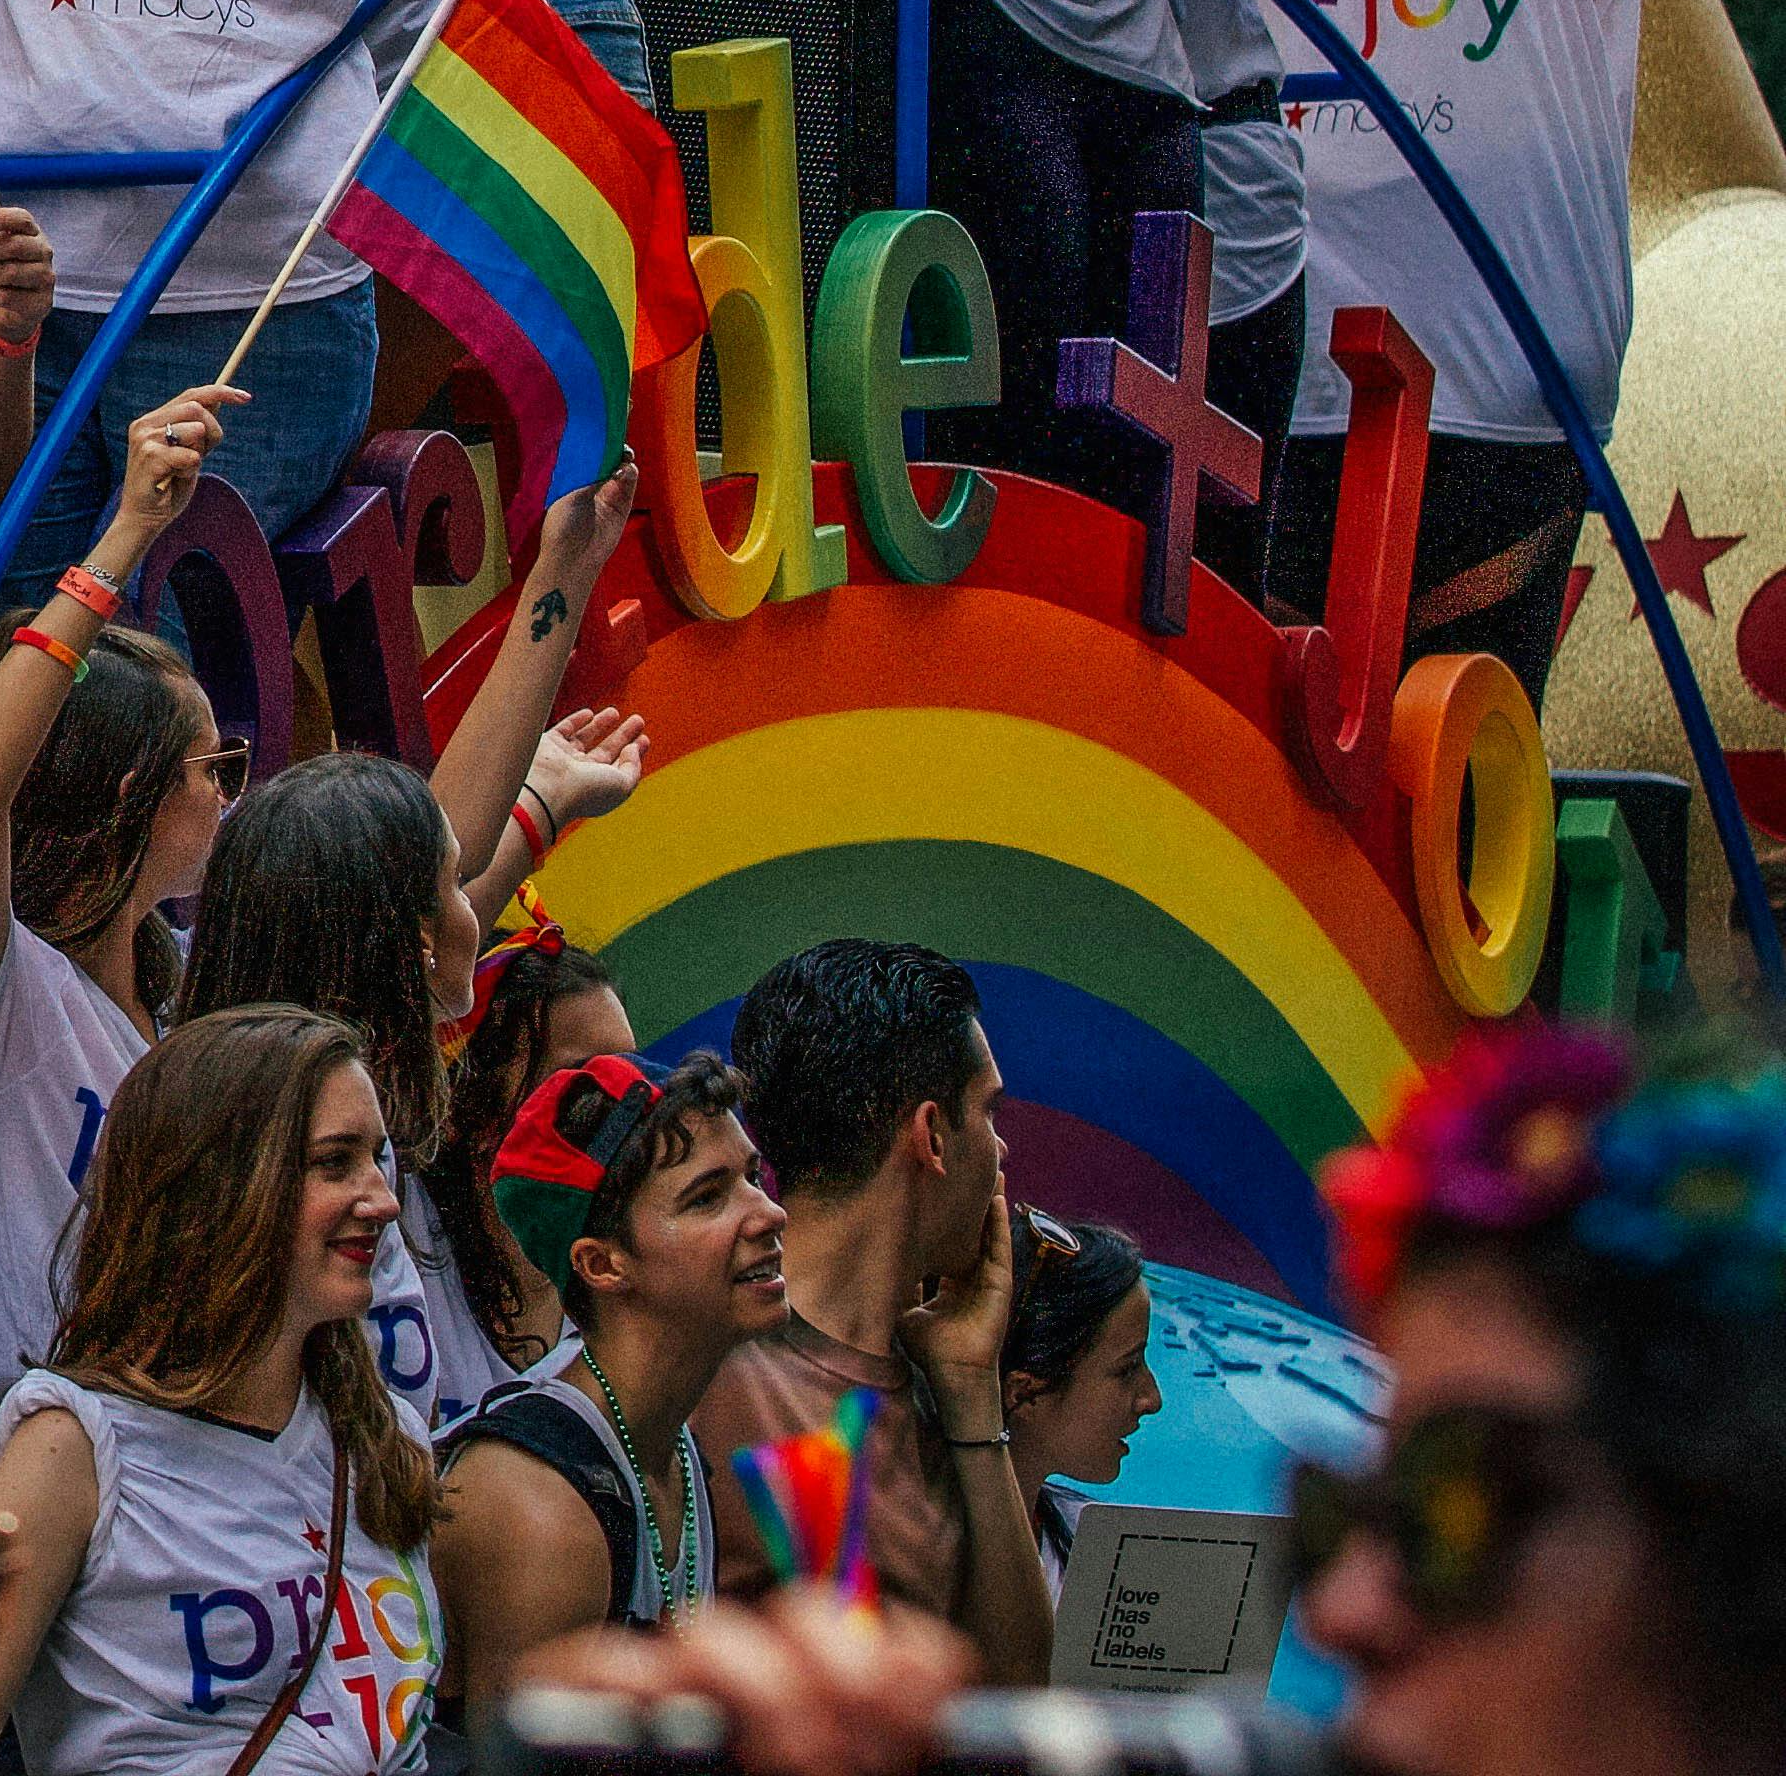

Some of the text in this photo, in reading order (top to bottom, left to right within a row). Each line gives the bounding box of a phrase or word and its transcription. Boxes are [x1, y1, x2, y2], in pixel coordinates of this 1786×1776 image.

[1115, 1584, 1160, 1606] love
[1111, 1604, 1151, 1624] has
[1107, 1622, 1136, 1639] no
[1102, 1638, 1167, 1661] labels
